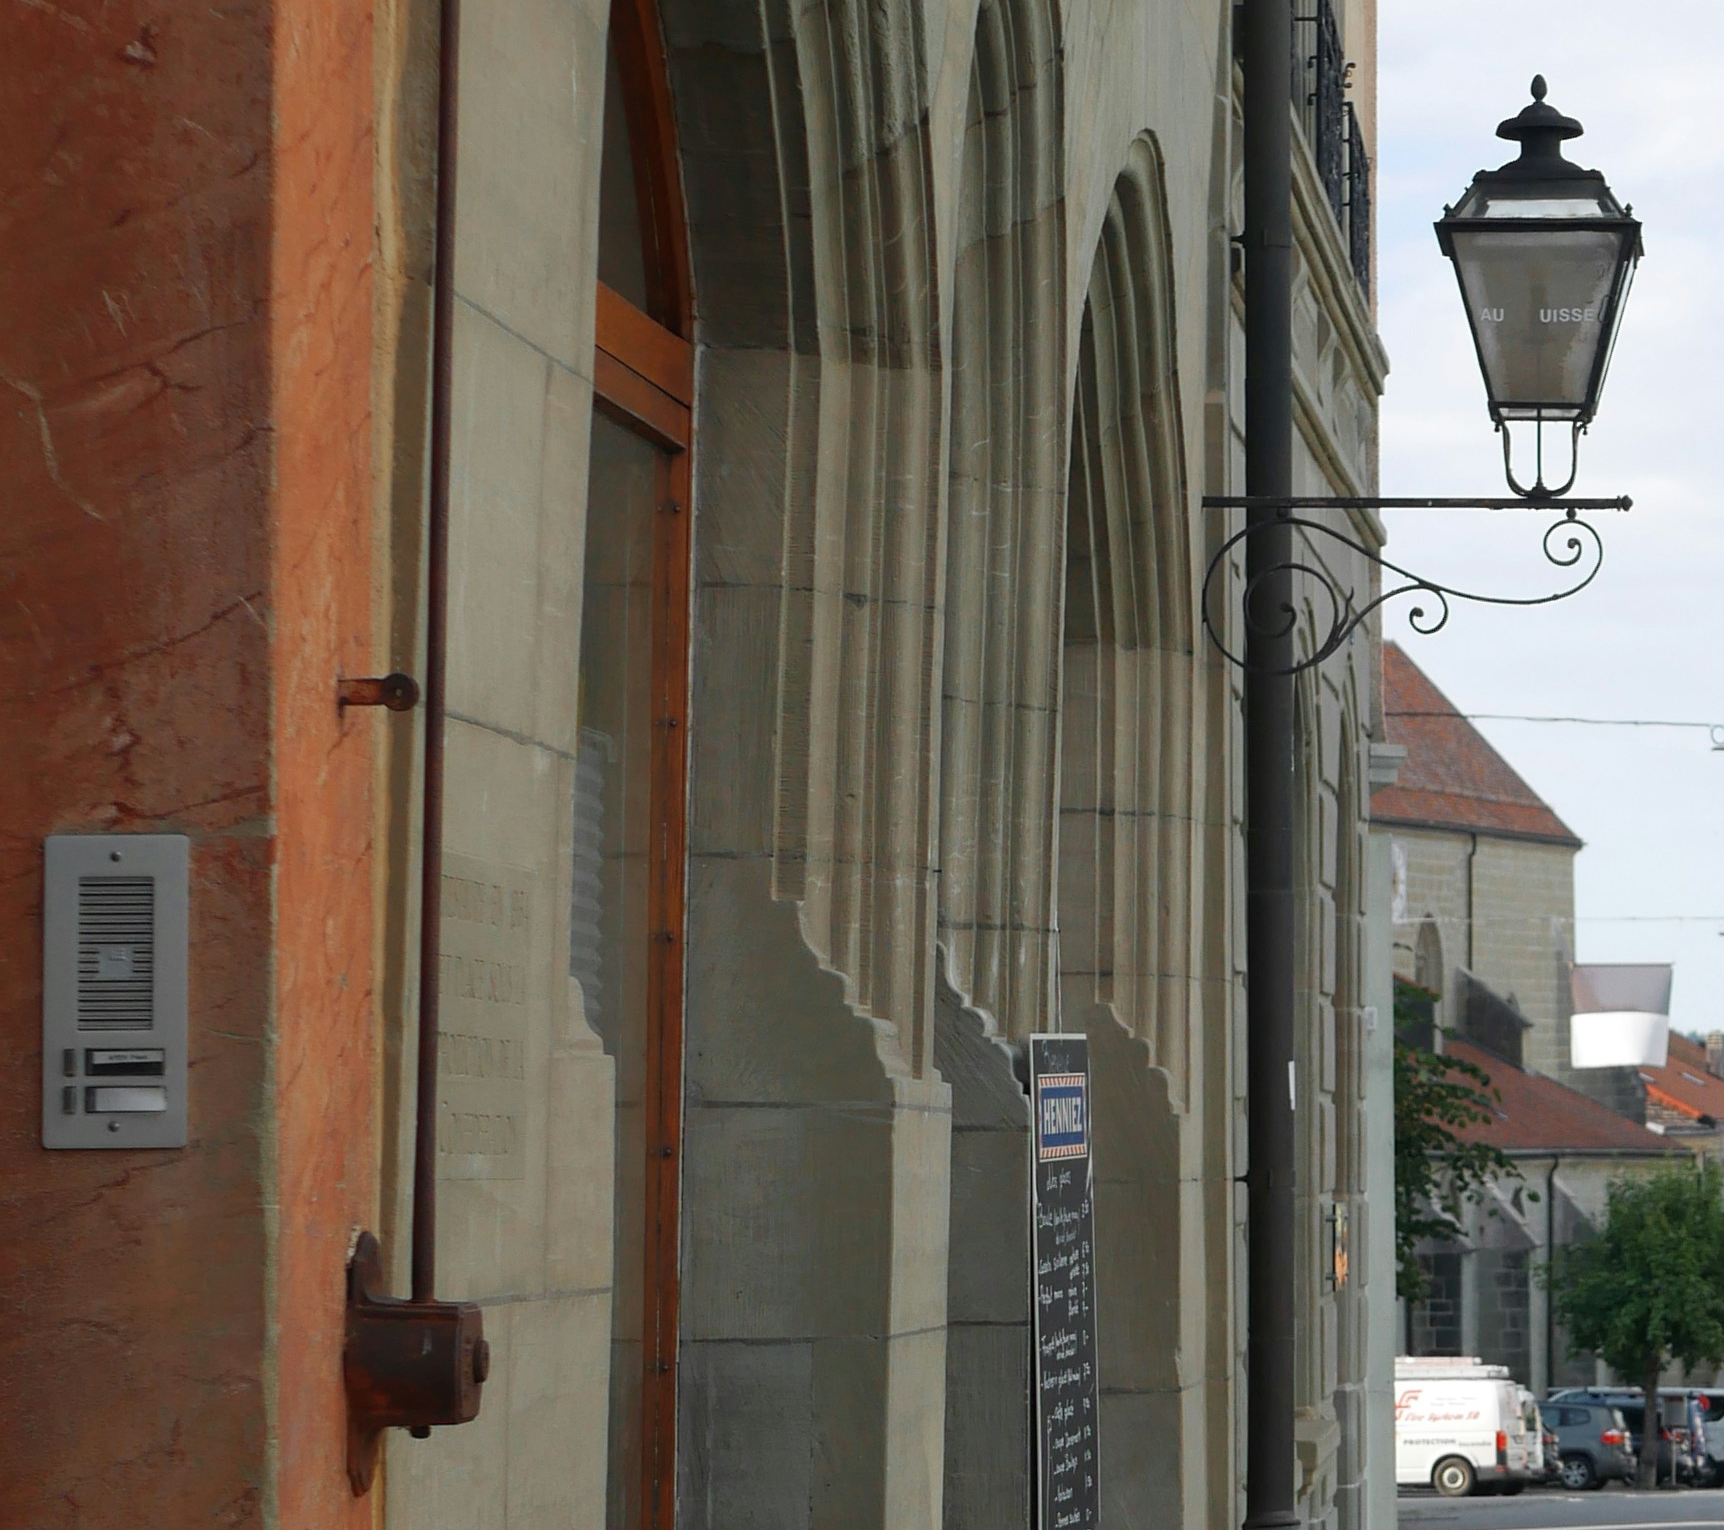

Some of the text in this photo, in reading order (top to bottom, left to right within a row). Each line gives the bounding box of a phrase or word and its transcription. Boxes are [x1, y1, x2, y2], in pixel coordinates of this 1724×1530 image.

[1480, 307, 1595, 324] AU UISSE
[1043, 1097, 1083, 1136] HENNIEZ
[1402, 1438, 1457, 1446] PROTECTION
